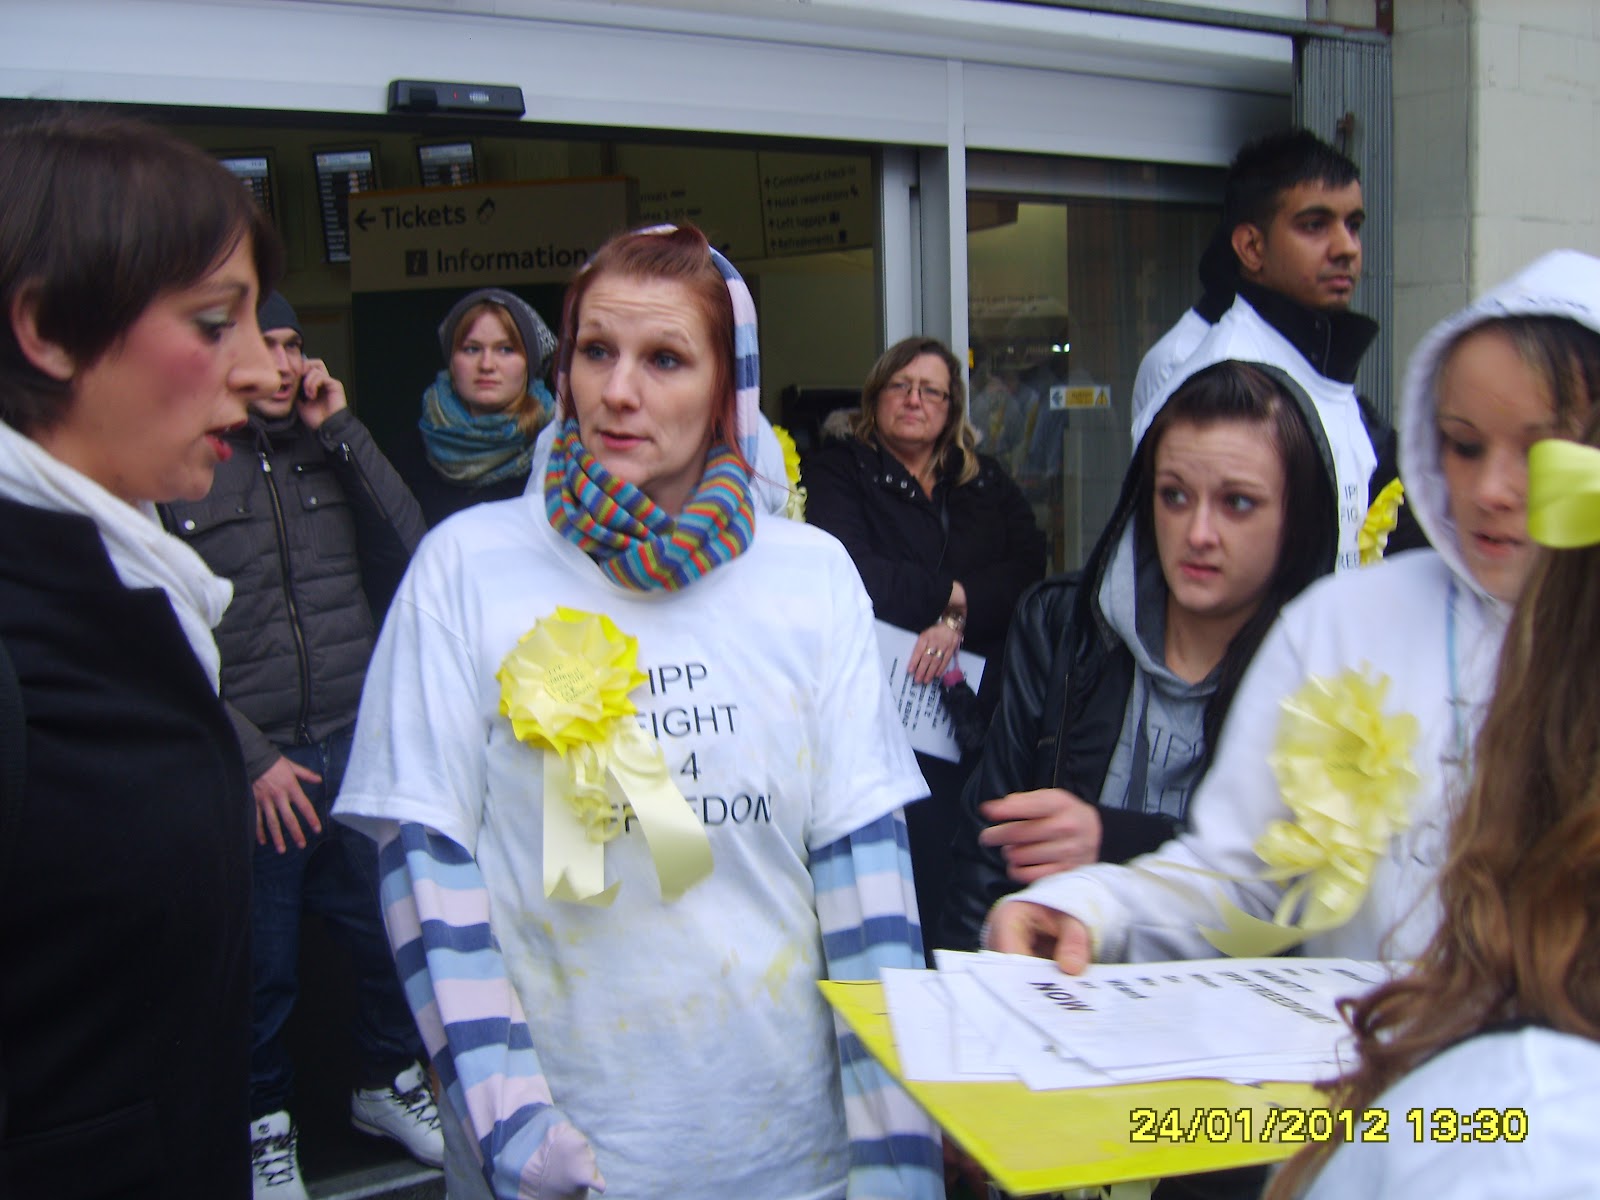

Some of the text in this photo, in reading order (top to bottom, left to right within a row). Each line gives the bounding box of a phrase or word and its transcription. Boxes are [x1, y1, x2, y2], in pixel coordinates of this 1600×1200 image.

[381, 203, 467, 231] Tickets
[437, 244, 588, 273] Information
[648, 663, 707, 696] IPP
[680, 752, 701, 781] 4
[1030, 982, 1096, 1011] NOW
